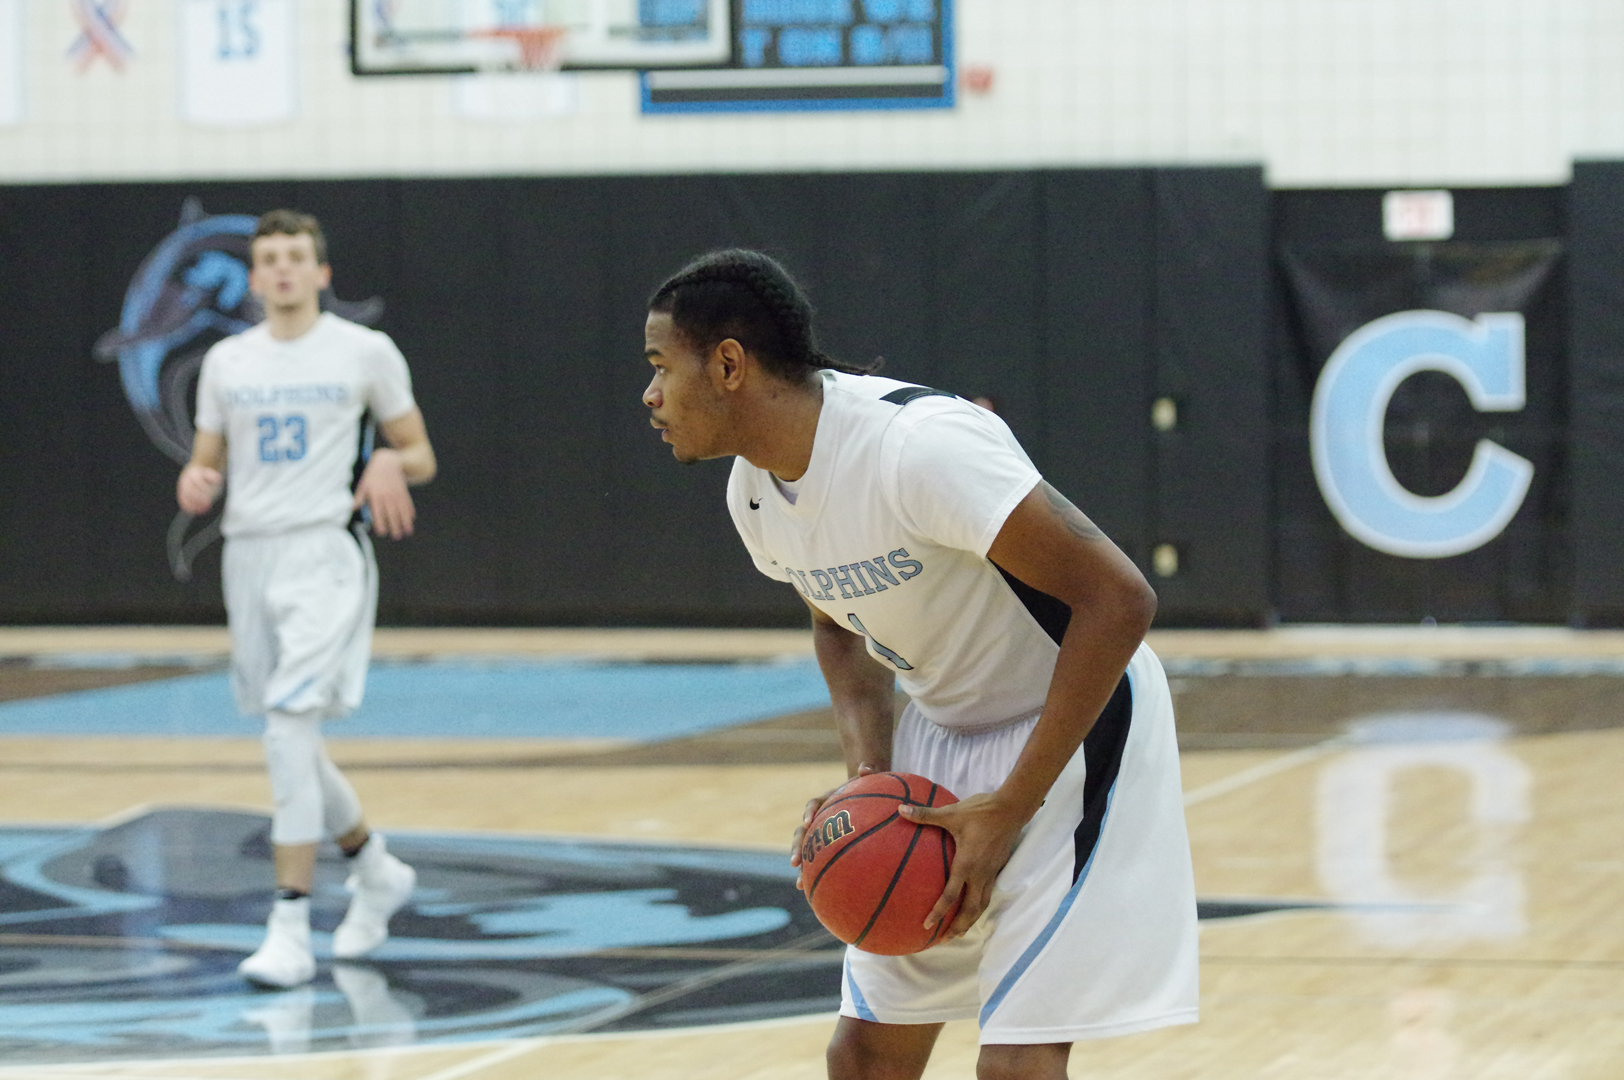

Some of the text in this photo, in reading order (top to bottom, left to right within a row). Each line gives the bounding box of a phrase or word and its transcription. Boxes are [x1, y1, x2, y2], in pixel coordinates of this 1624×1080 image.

[257, 415, 308, 462] 23
[1309, 309, 1535, 559] C
[772, 547, 923, 601] OLPHINS
[847, 613, 914, 671] 1
